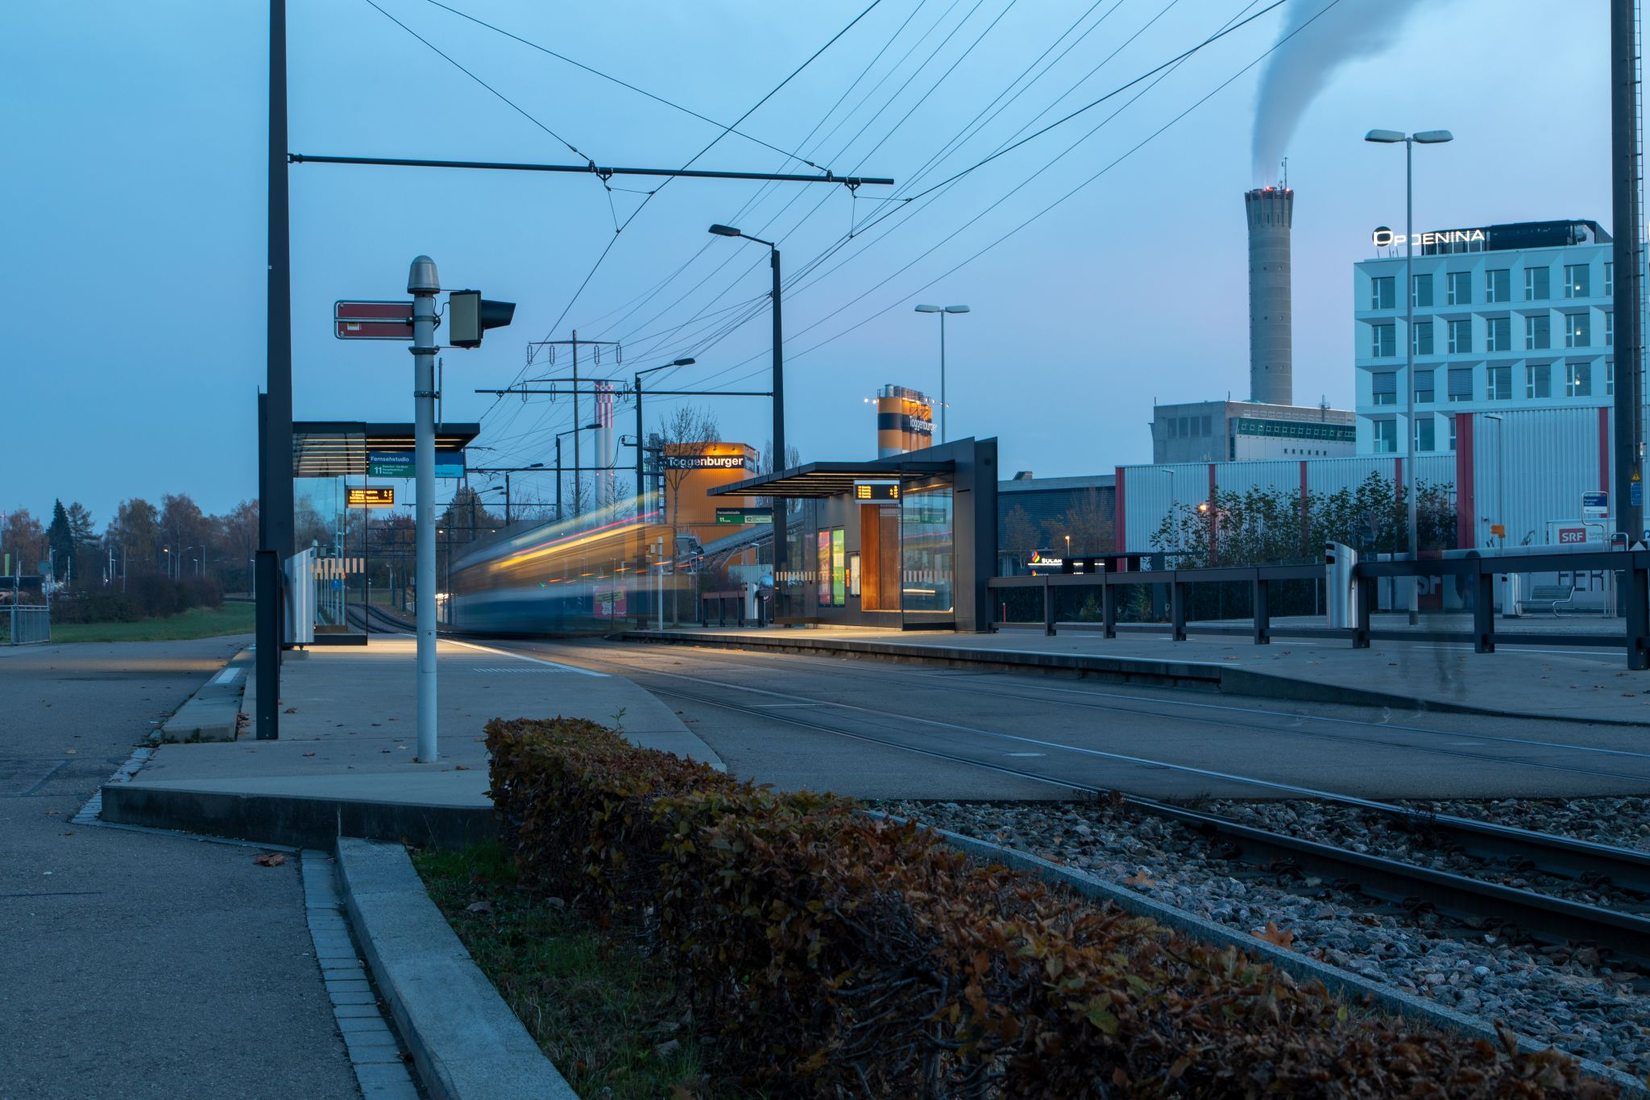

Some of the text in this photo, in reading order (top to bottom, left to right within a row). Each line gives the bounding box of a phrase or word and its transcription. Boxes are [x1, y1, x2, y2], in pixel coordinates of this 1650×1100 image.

[667, 456, 744, 469] Toggenburger
[374, 466, 383, 475] 11
[1561, 532, 1584, 542] SRF
